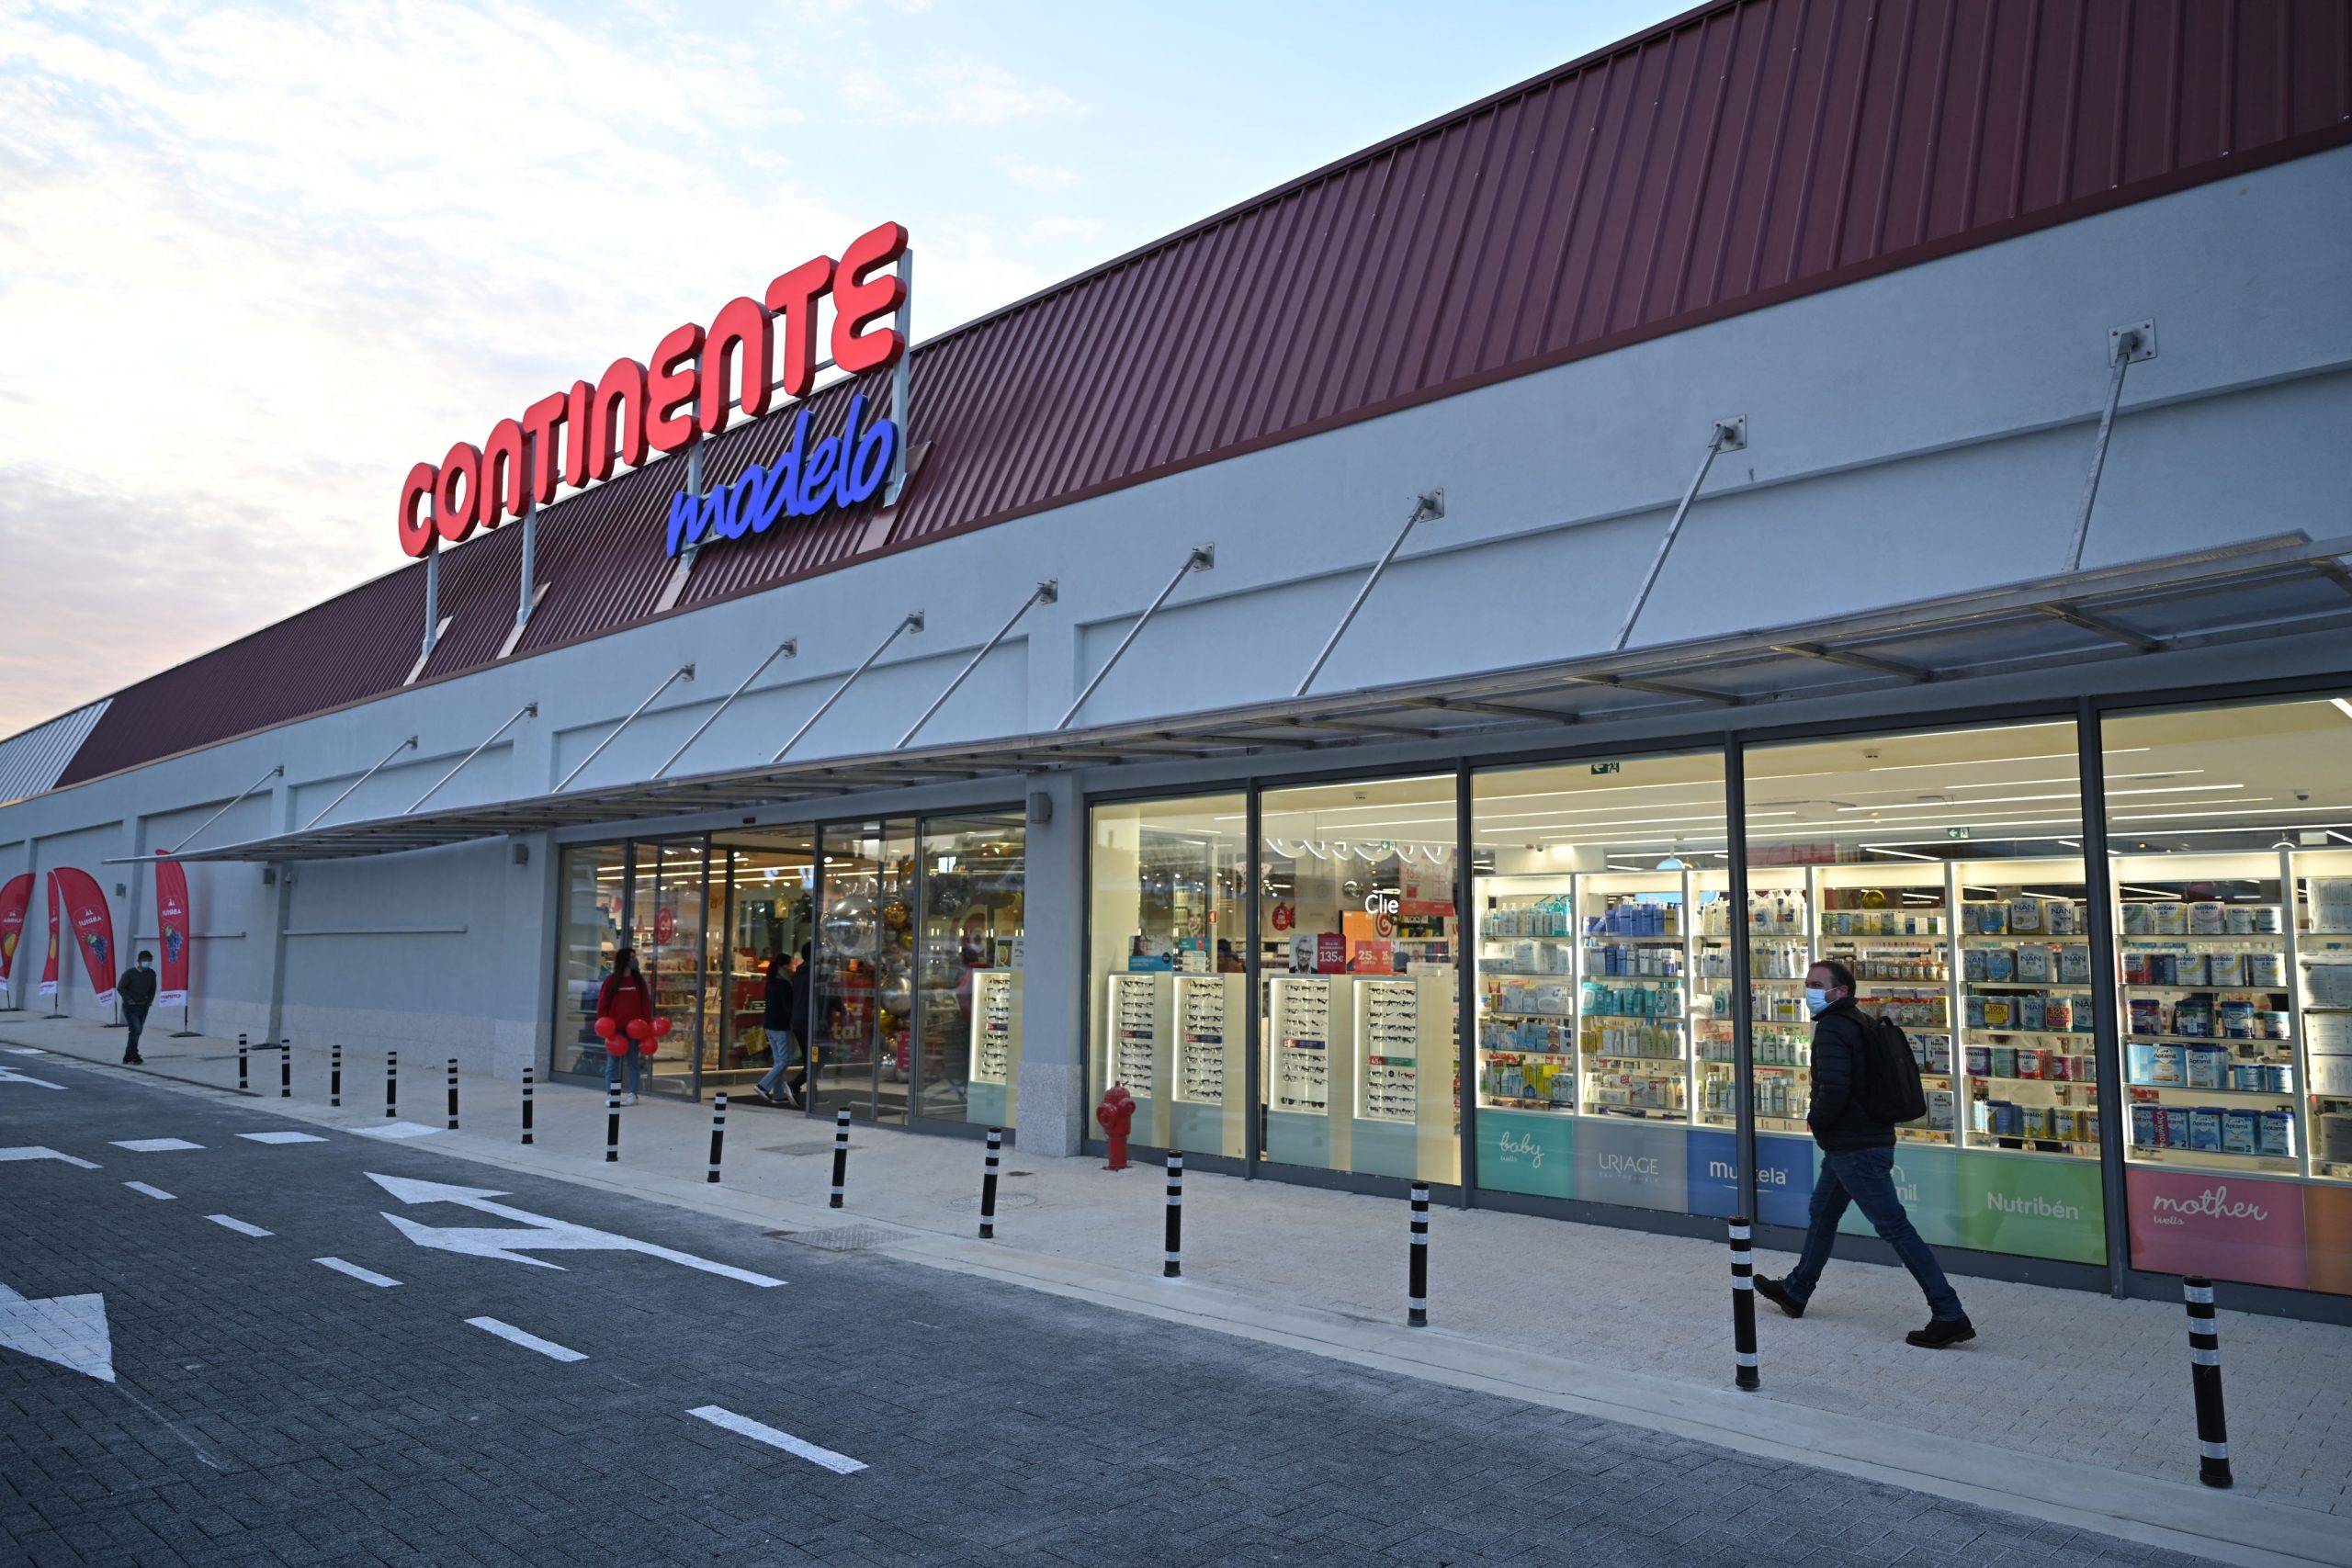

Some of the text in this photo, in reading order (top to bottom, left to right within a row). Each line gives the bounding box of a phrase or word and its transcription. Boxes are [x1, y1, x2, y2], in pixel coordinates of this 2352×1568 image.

[398, 220, 909, 558] CONTINENTE
[666, 393, 899, 558] modelo
[2014, 903, 2036, 911] NAN
[1499, 1131, 1544, 1168] baby
[1599, 1153, 1659, 1175] URIAGE
[1709, 1160, 1786, 1185] muela
[1987, 1191, 2079, 1221] Nutribén
[2153, 1185, 2268, 1221] mother
